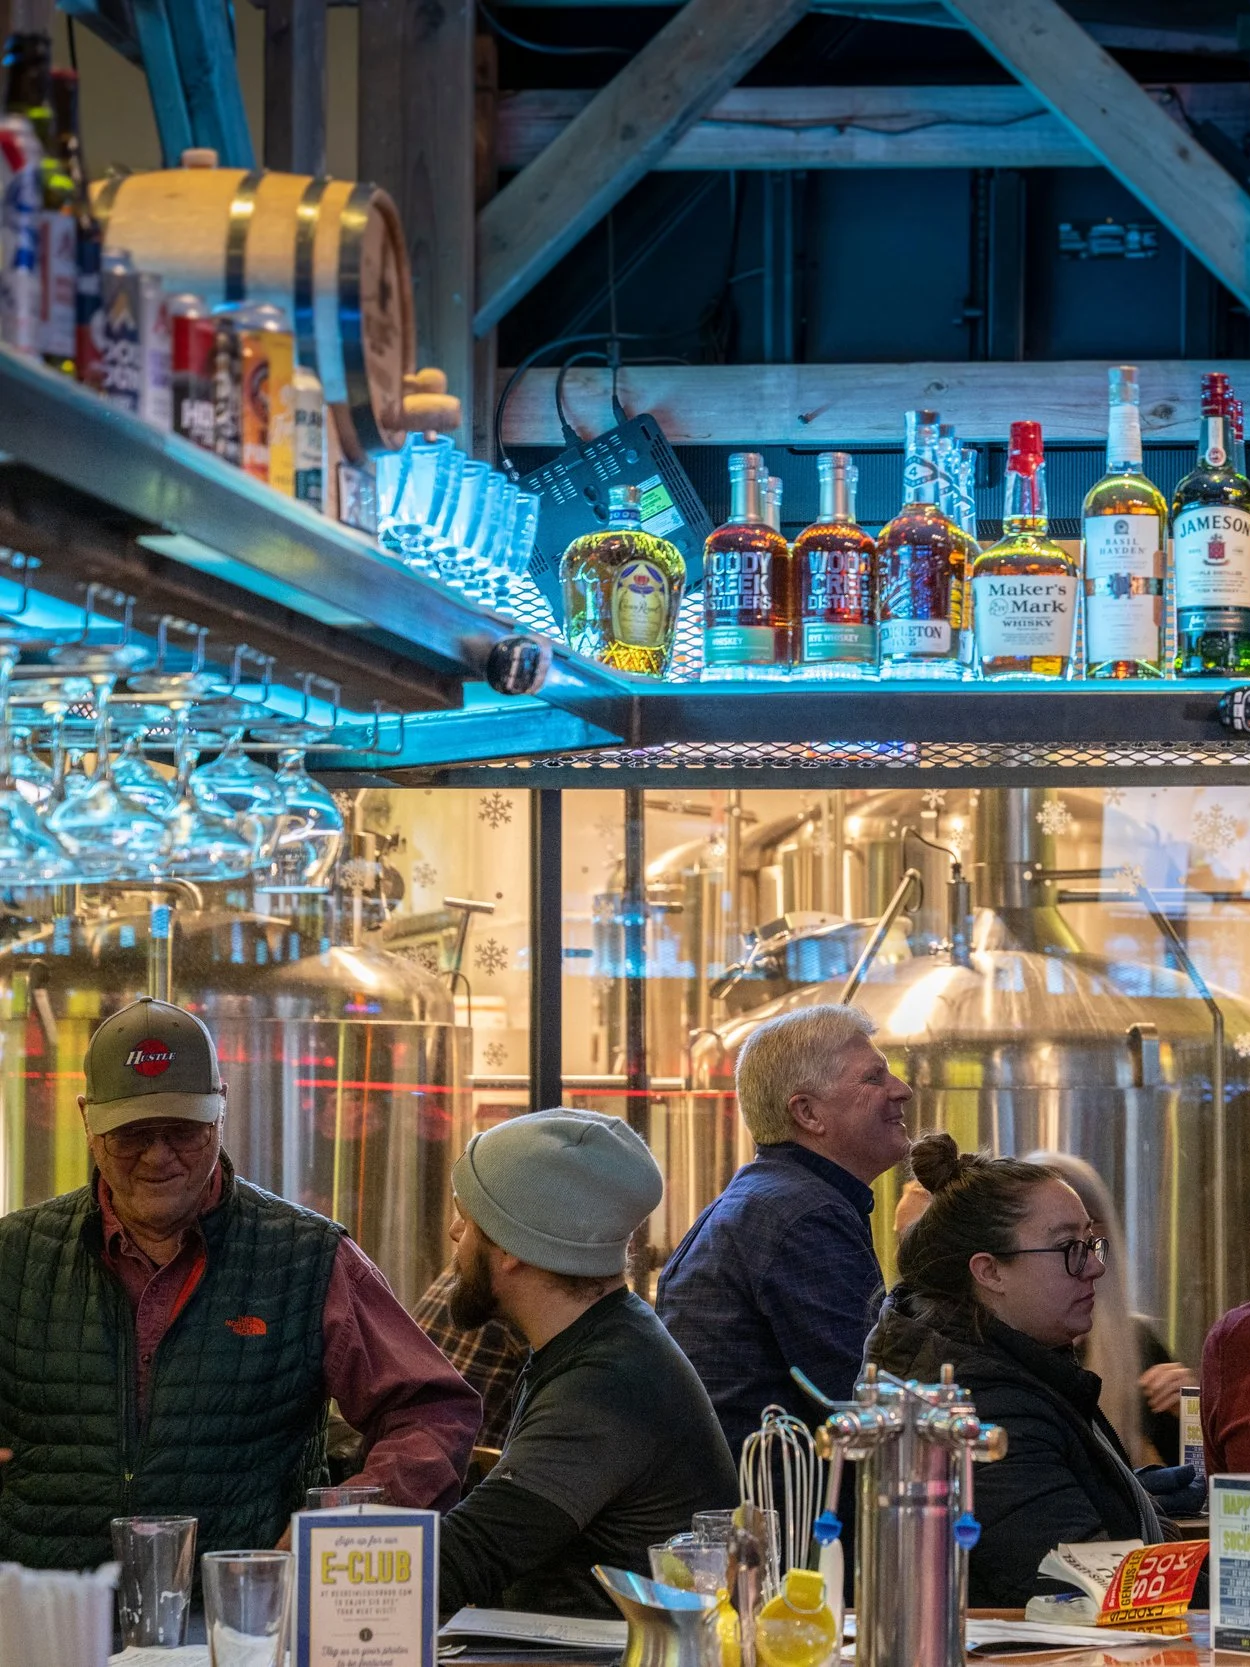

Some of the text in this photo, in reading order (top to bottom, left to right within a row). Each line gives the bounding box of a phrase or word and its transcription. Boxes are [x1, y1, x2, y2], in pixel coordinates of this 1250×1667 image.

[1105, 538, 1139, 546] BASIL
[1099, 547, 1145, 555] HAYDEN
[706, 551, 772, 575] OODY
[988, 583, 1067, 597] Maker's
[1011, 600, 1067, 613] Mark
[367, 1535, 382, 1547] for
[321, 1550, 412, 1584] E-CLUB
[1120, 1548, 1147, 1607] GENIUS-LE
